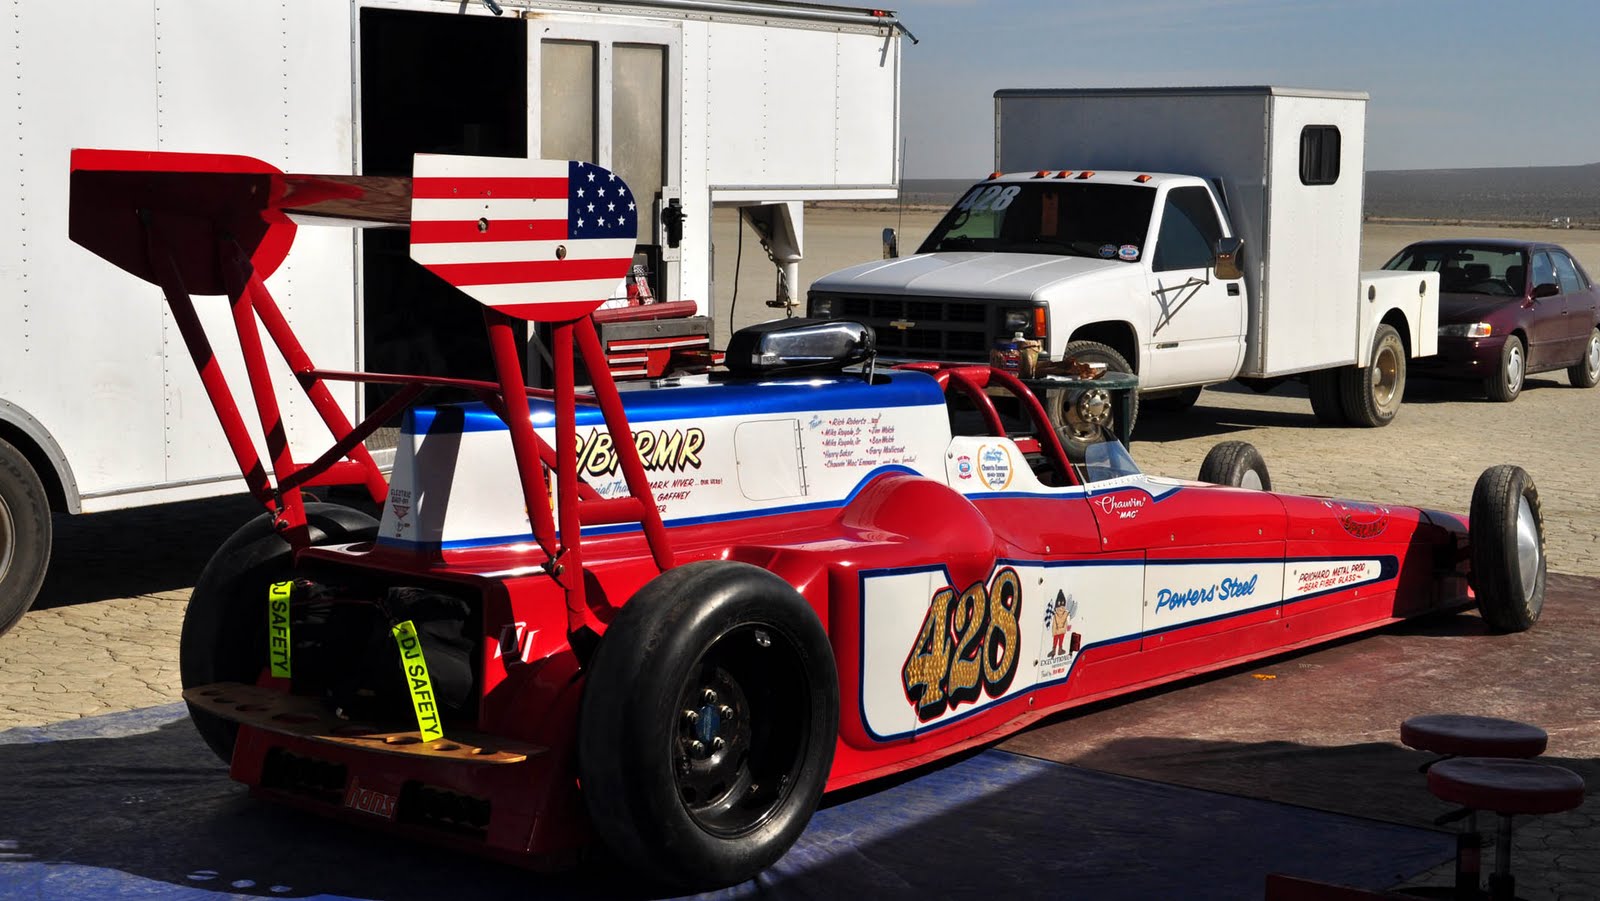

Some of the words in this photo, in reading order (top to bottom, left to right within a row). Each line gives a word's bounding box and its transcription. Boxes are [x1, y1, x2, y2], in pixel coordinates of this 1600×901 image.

[958, 185, 1021, 211] 428
[846, 417, 867, 426] Roberts
[671, 478, 695, 489] NIVER
[656, 490, 691, 502] GAFFNEY
[1332, 565, 1350, 577] METAL
[1218, 573, 1258, 601] Steel
[272, 600, 289, 673] SAFETY
[401, 637, 420, 660] DJ
[901, 566, 1023, 724] 428
[408, 664, 440, 735] SAFETY
